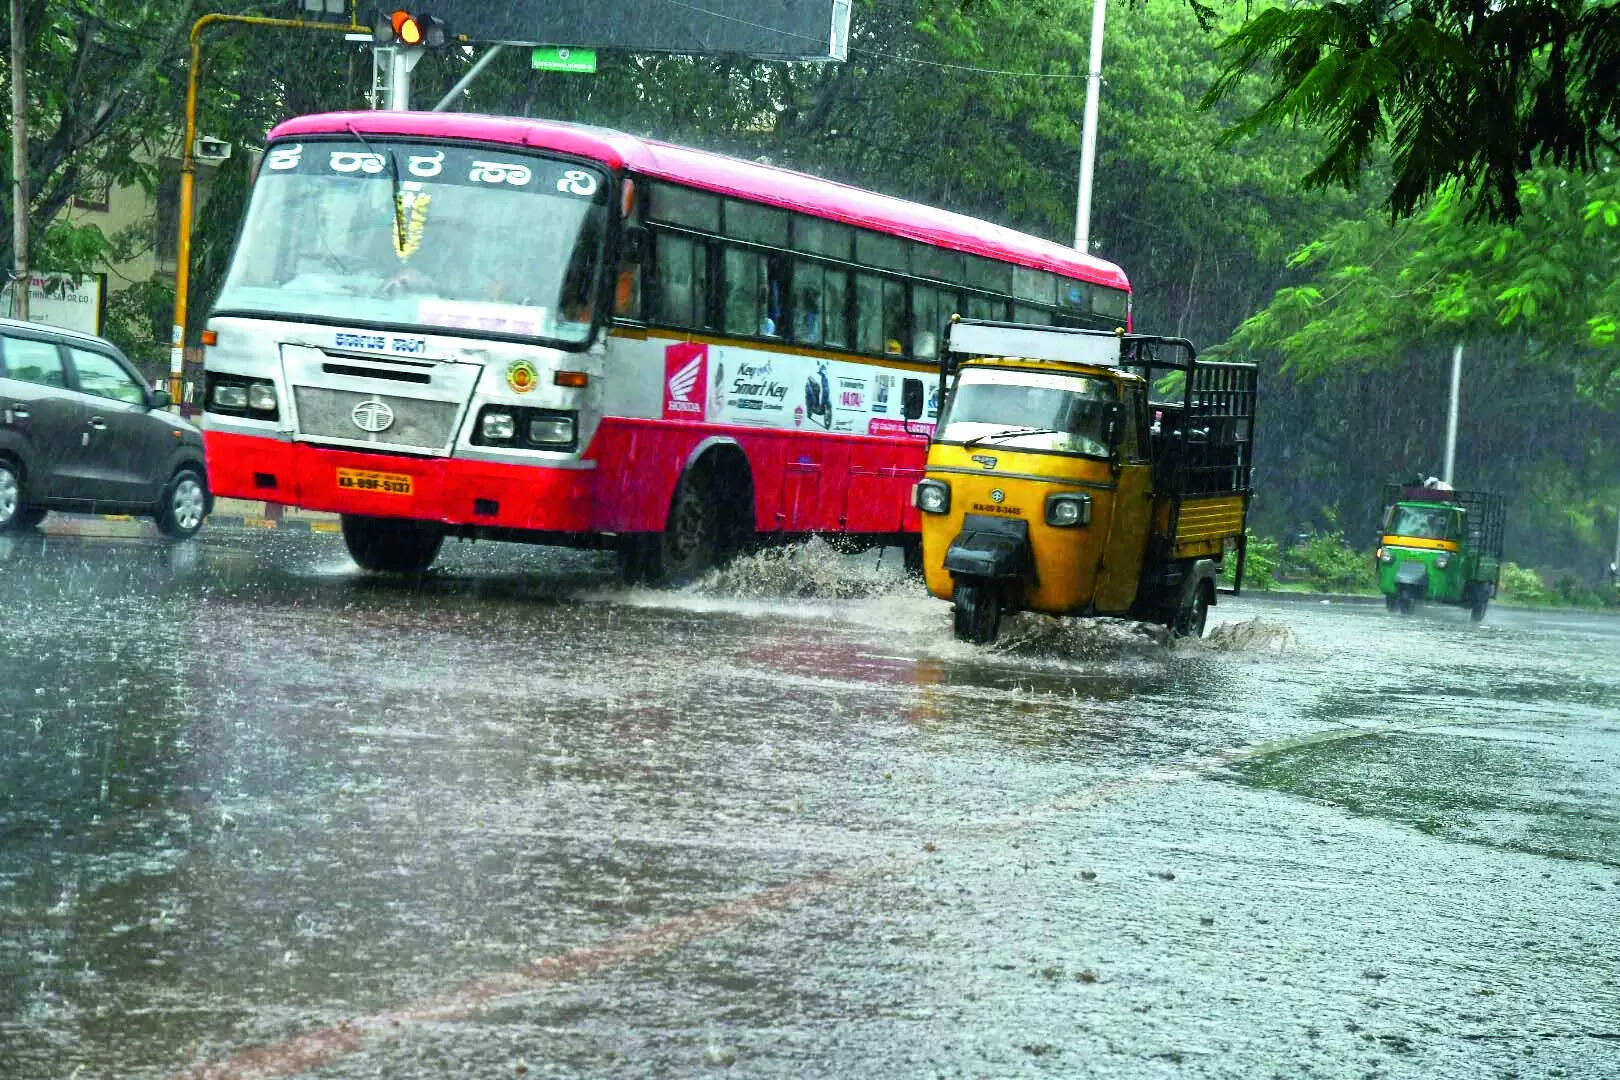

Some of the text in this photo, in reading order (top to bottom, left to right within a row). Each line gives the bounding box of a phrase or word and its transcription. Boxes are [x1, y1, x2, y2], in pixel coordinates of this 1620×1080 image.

[737, 362, 757, 379] Key
[729, 378, 788, 402] Smart Key
[668, 400, 700, 412] HONDA
